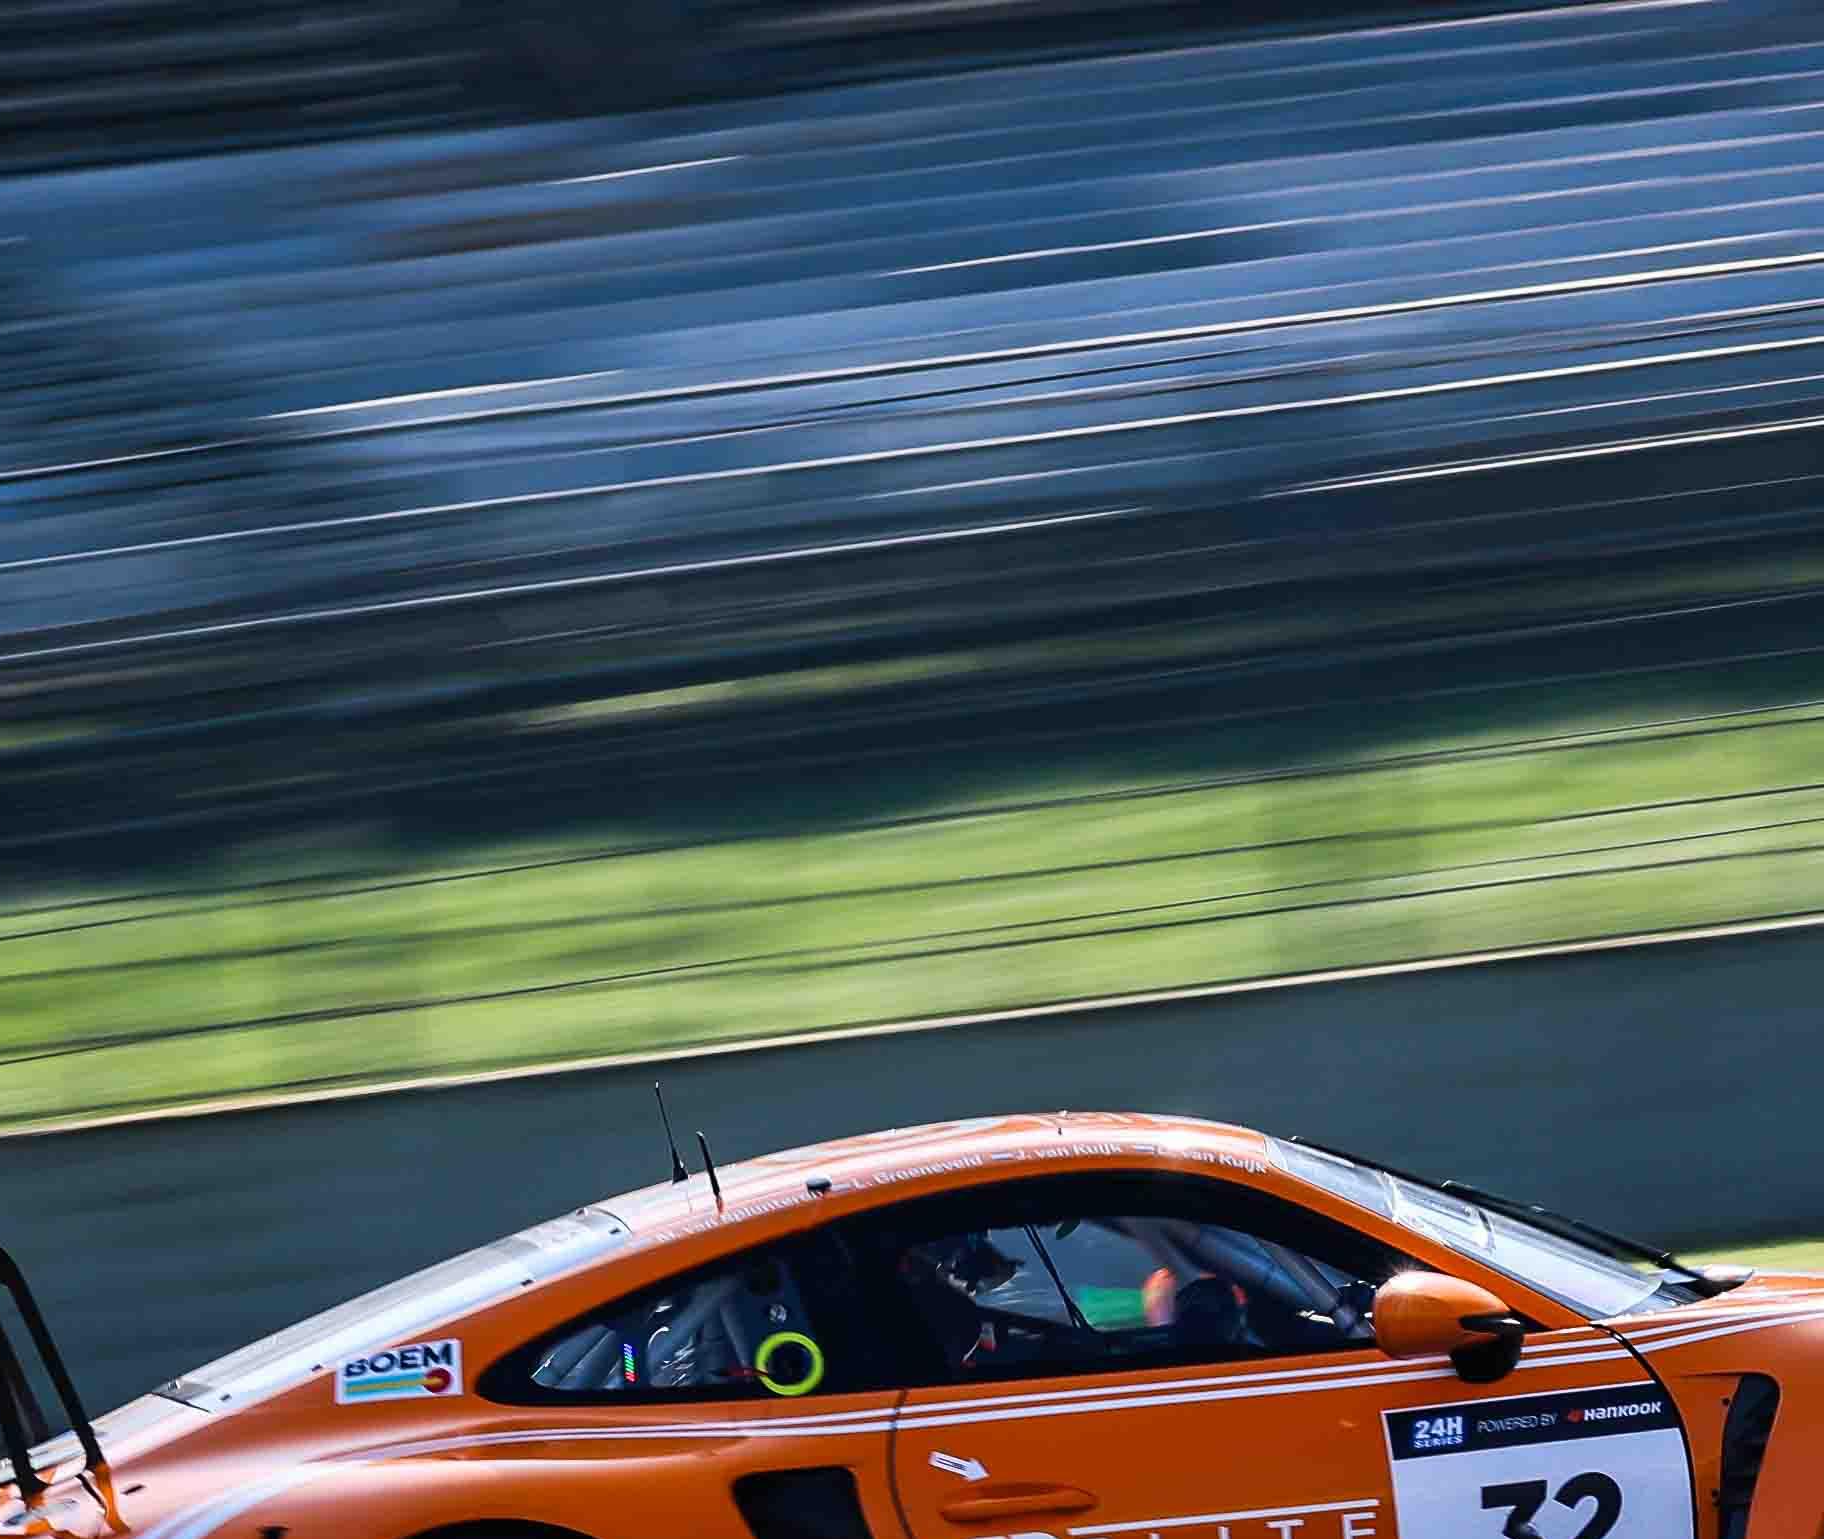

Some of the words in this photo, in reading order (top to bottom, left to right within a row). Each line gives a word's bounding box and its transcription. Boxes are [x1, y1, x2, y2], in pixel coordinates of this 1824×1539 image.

[1036, 1147, 1071, 1159] van
[344, 1343, 453, 1377] BOEM
[1414, 1416, 1464, 1440] 24H
[1477, 1413, 1538, 1433] POWERED
[1540, 1413, 1558, 1427] BY
